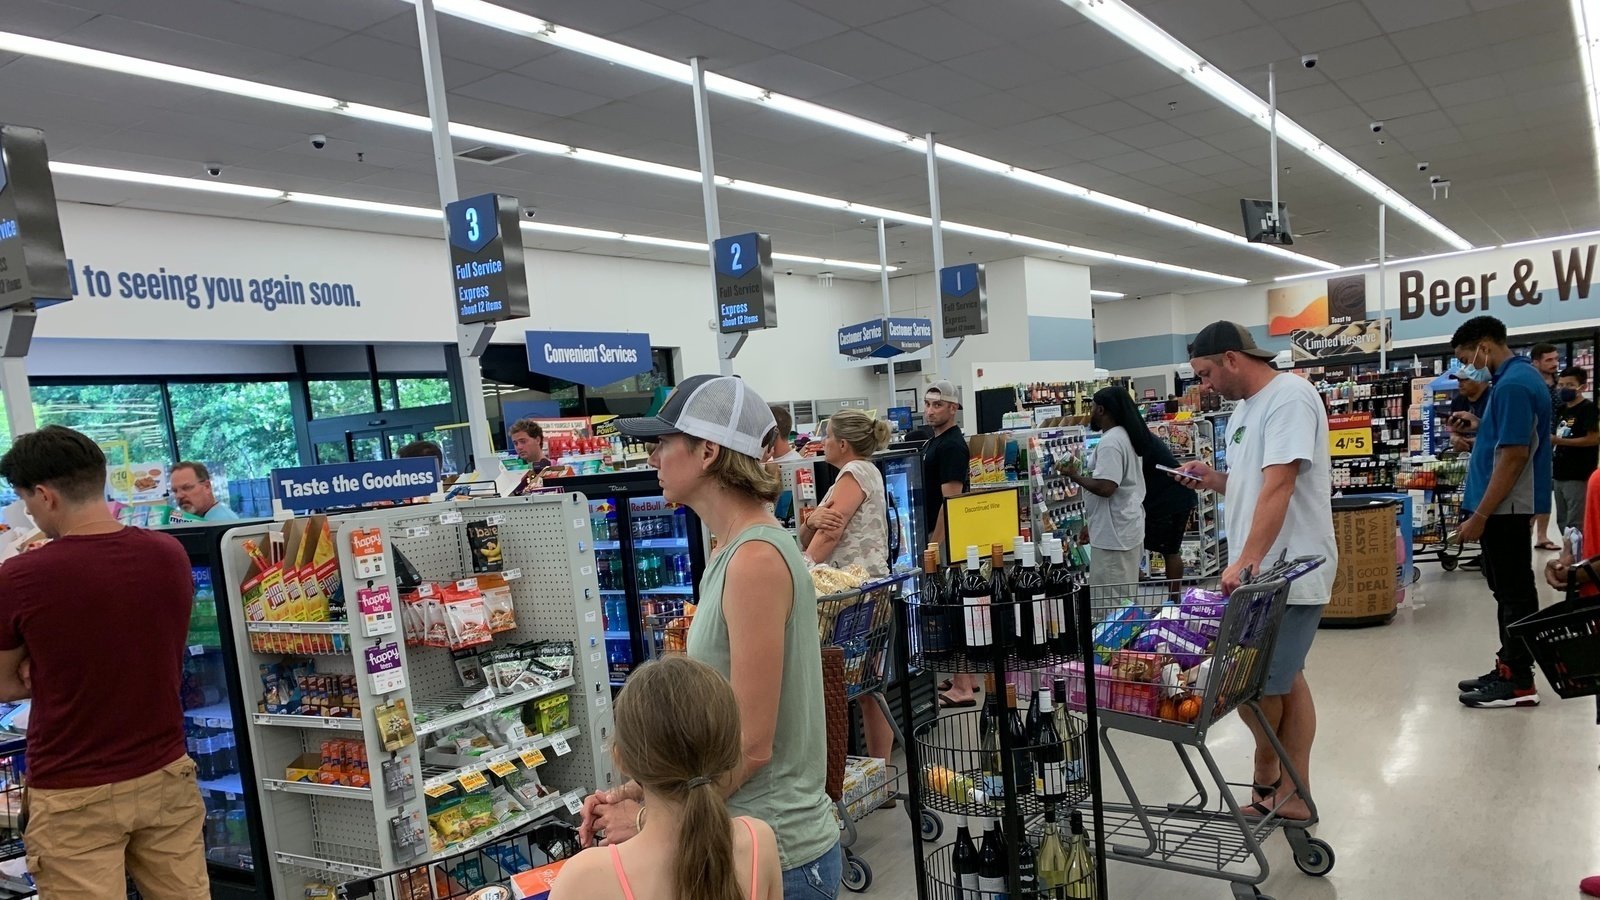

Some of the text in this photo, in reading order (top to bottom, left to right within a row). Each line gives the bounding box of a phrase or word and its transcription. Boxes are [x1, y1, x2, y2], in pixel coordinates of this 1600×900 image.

[466, 208, 479, 241] 3
[731, 243, 742, 270] 2
[456, 259, 502, 280] Full Service
[83, 265, 111, 297] to
[119, 267, 198, 309] seeing
[202, 276, 244, 310] you
[250, 275, 305, 311] again
[310, 280, 361, 307] soon.
[1400, 244, 1598, 321] Beer & W
[459, 286, 489, 303] Express
[719, 283, 760, 299] Full Service
[461, 300, 502, 316] about 12 items
[721, 303, 748, 317] Express
[955, 301, 978, 311] Service
[722, 314, 759, 327] about 12 items
[1331, 316, 1345, 324] Toast
[839, 325, 882, 346] Customer Service
[889, 321, 931, 337] Customer Service
[1305, 333, 1377, 350] Limited Reserve
[544, 343, 638, 364] Convenient Services
[596, 425, 617, 435] POWER
[1335, 437, 1365, 449] 4/$5
[281, 469, 434, 498] Taste the Goodness
[631, 501, 661, 512] Red Bull
[964, 504, 990, 513] Discontinued
[477, 527, 498, 538] bare
[1355, 518, 1366, 555] EASY
[1369, 516, 1379, 554] VALUE
[354, 534, 382, 549] happy
[191, 570, 210, 582] epsi
[1357, 566, 1389, 579] GOOD
[1357, 579, 1389, 592] DEAL
[362, 591, 391, 607] happy
[1330, 597, 1353, 607] LUE
[1368, 594, 1376, 612] BIG
[369, 647, 400, 666] happy
[380, 662, 393, 670] teen
